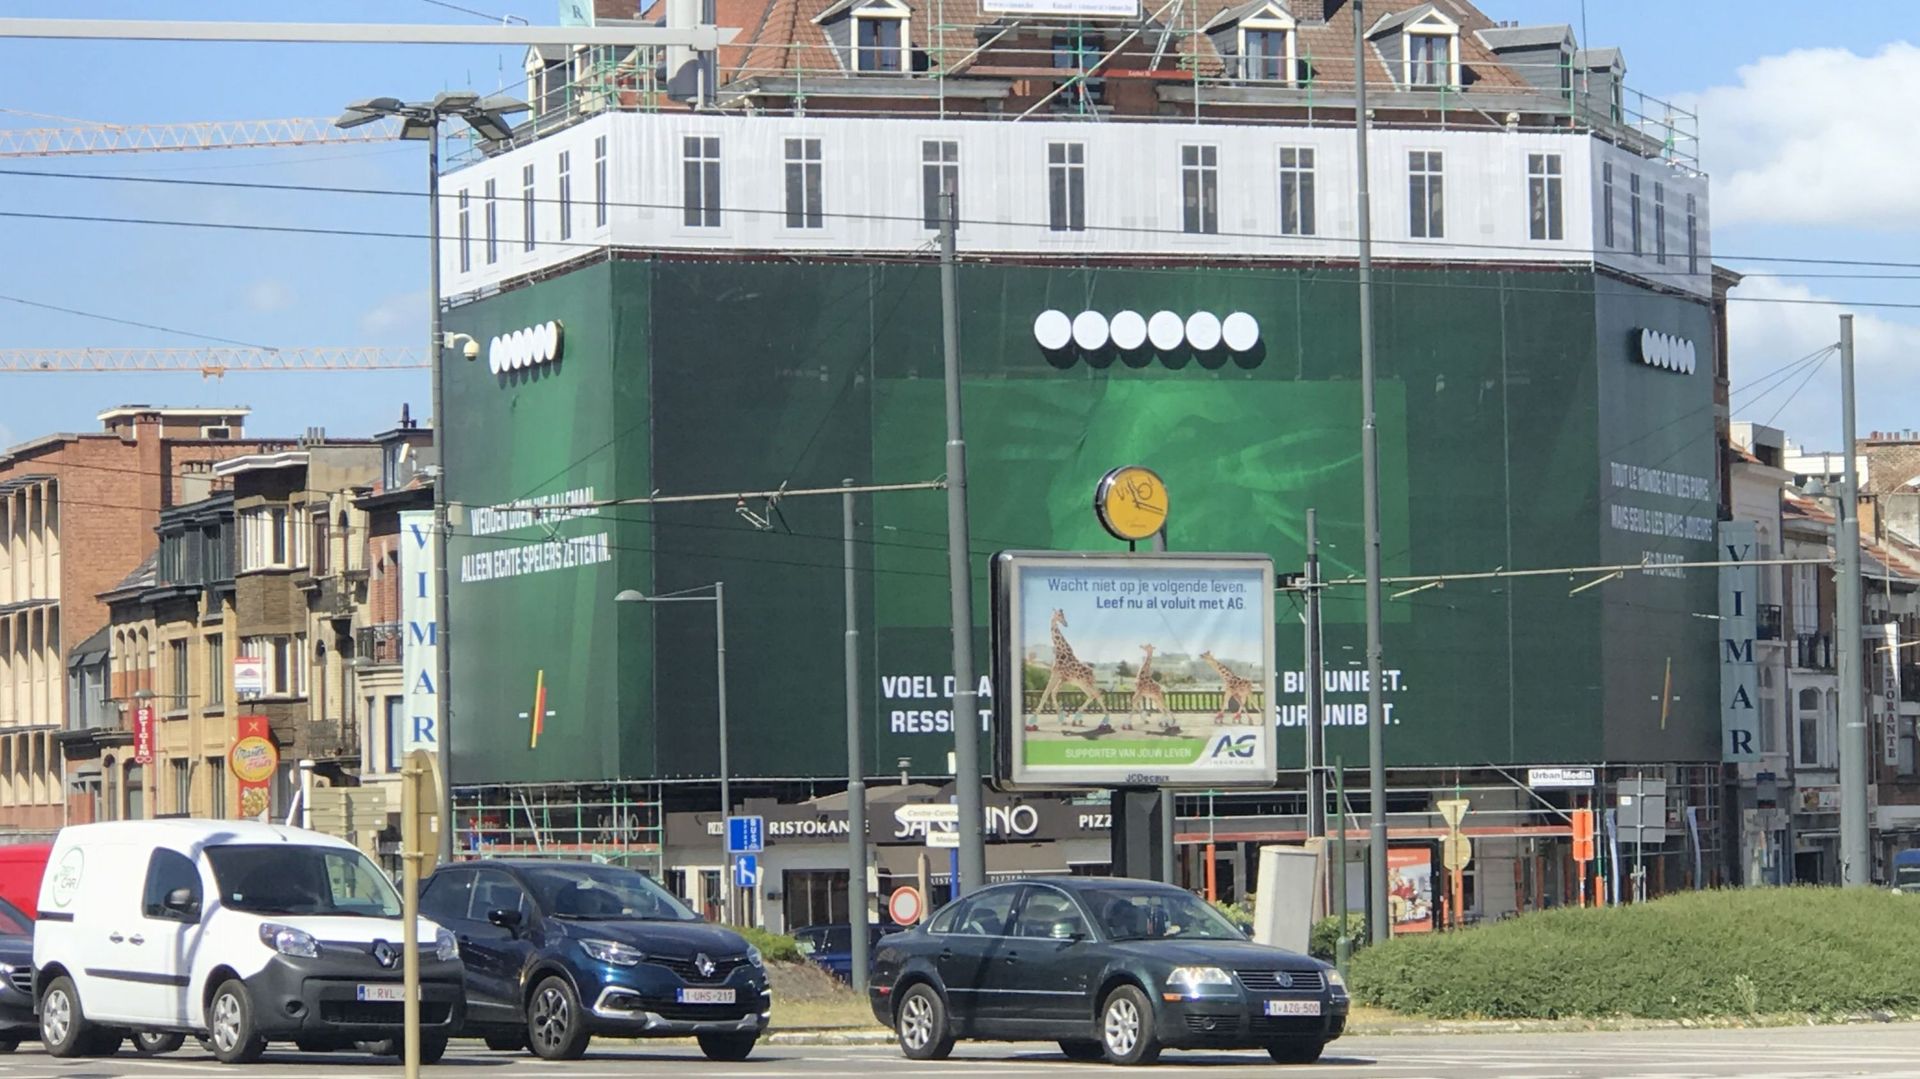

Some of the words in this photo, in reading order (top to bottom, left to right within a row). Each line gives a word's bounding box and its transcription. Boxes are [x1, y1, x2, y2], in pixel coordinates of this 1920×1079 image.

[461, 552, 493, 582] ALLEEN
[494, 547, 521, 578] ECHTE
[522, 541, 562, 574] SPELERS
[563, 535, 597, 568] ZETTEN
[1048, 579, 1088, 592] Wacht
[1092, 579, 1116, 592] niet
[1120, 582, 1135, 595] op
[1138, 579, 1149, 595] je
[1152, 579, 1208, 595] volgende
[1211, 580, 1247, 593] leven.
[1096, 596, 1124, 609] Leef
[1127, 599, 1143, 609] nu
[1146, 597, 1158, 609] al
[1160, 596, 1195, 609] voluit
[1199, 598, 1224, 610] met
[408, 523, 437, 743] VIMAR
[1726, 544, 1754, 754] VIMAR
[882, 675, 938, 698] VOEL
[1065, 748, 1117, 758] SUPPORTER
[1119, 748, 1136, 758] VAN
[1137, 748, 1162, 758] JOUW
[1164, 748, 1192, 758] LEVEN
[1211, 734, 1257, 758] AG
[1125, 773, 1170, 782] JCDecaux
[1532, 771, 1560, 780] Urban
